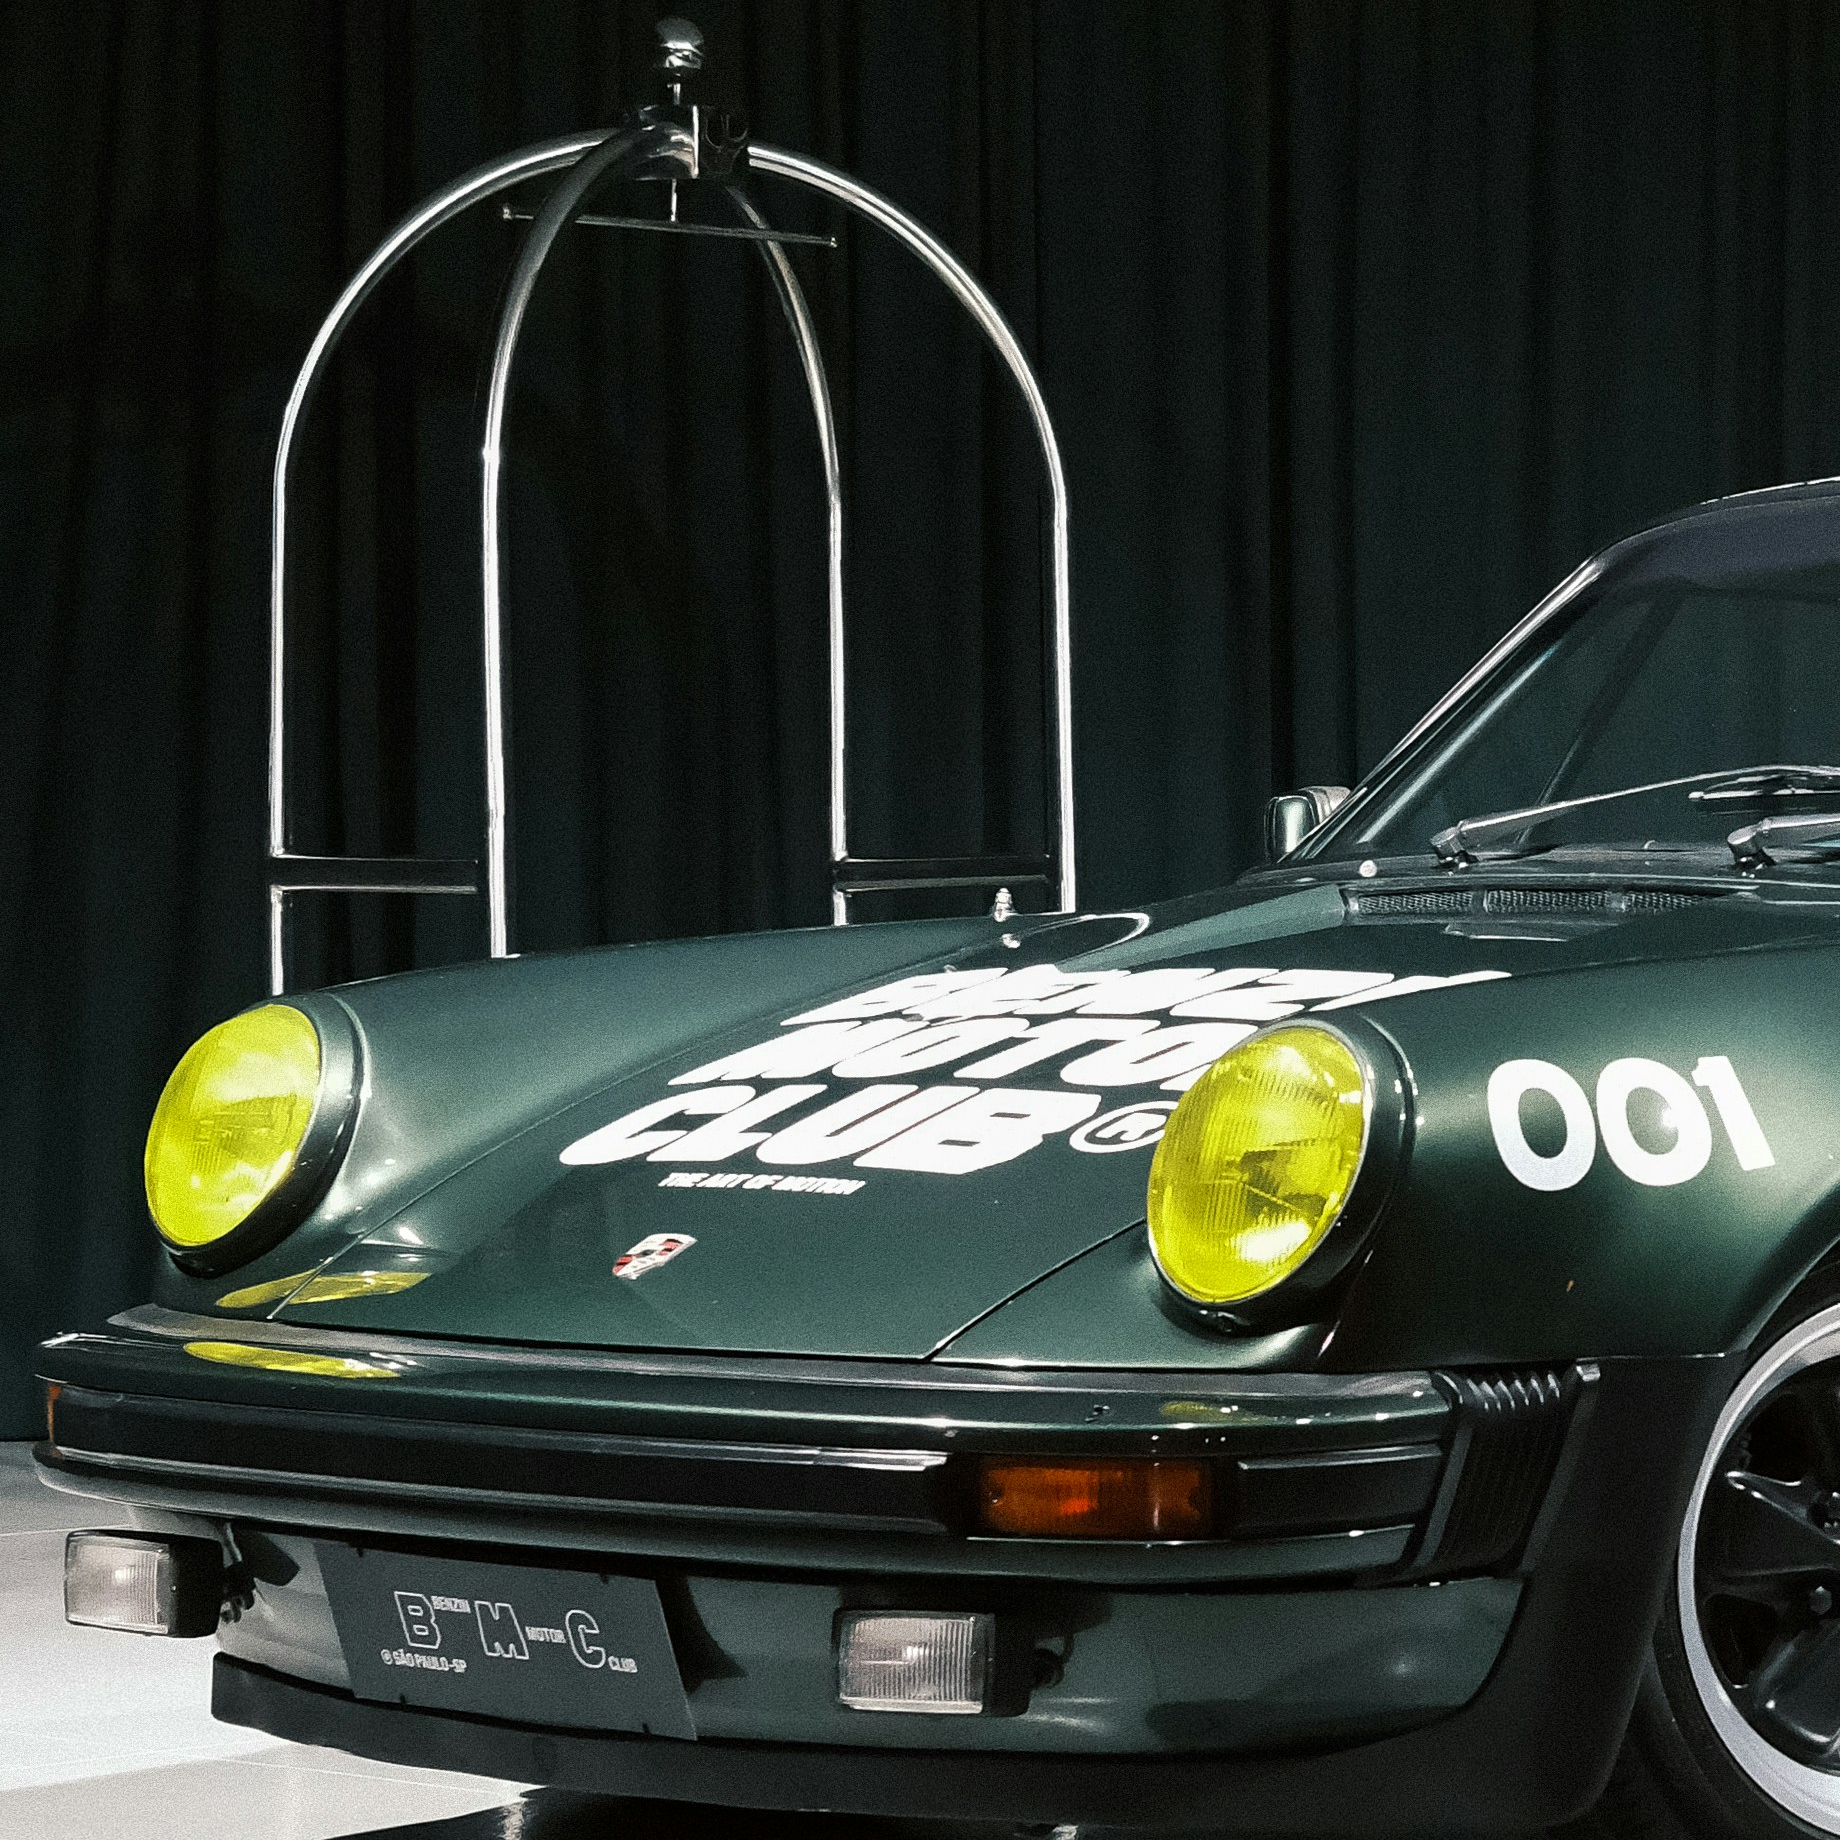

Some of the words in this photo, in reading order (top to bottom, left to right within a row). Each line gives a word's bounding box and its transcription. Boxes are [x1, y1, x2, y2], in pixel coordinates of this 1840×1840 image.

[667, 1017, 1258, 1092] MOTO
[1487, 1055, 1776, 1191] 001
[394, 1591, 441, 1649] B
[474, 1600, 530, 1660] M
[565, 1609, 606, 1669] C
